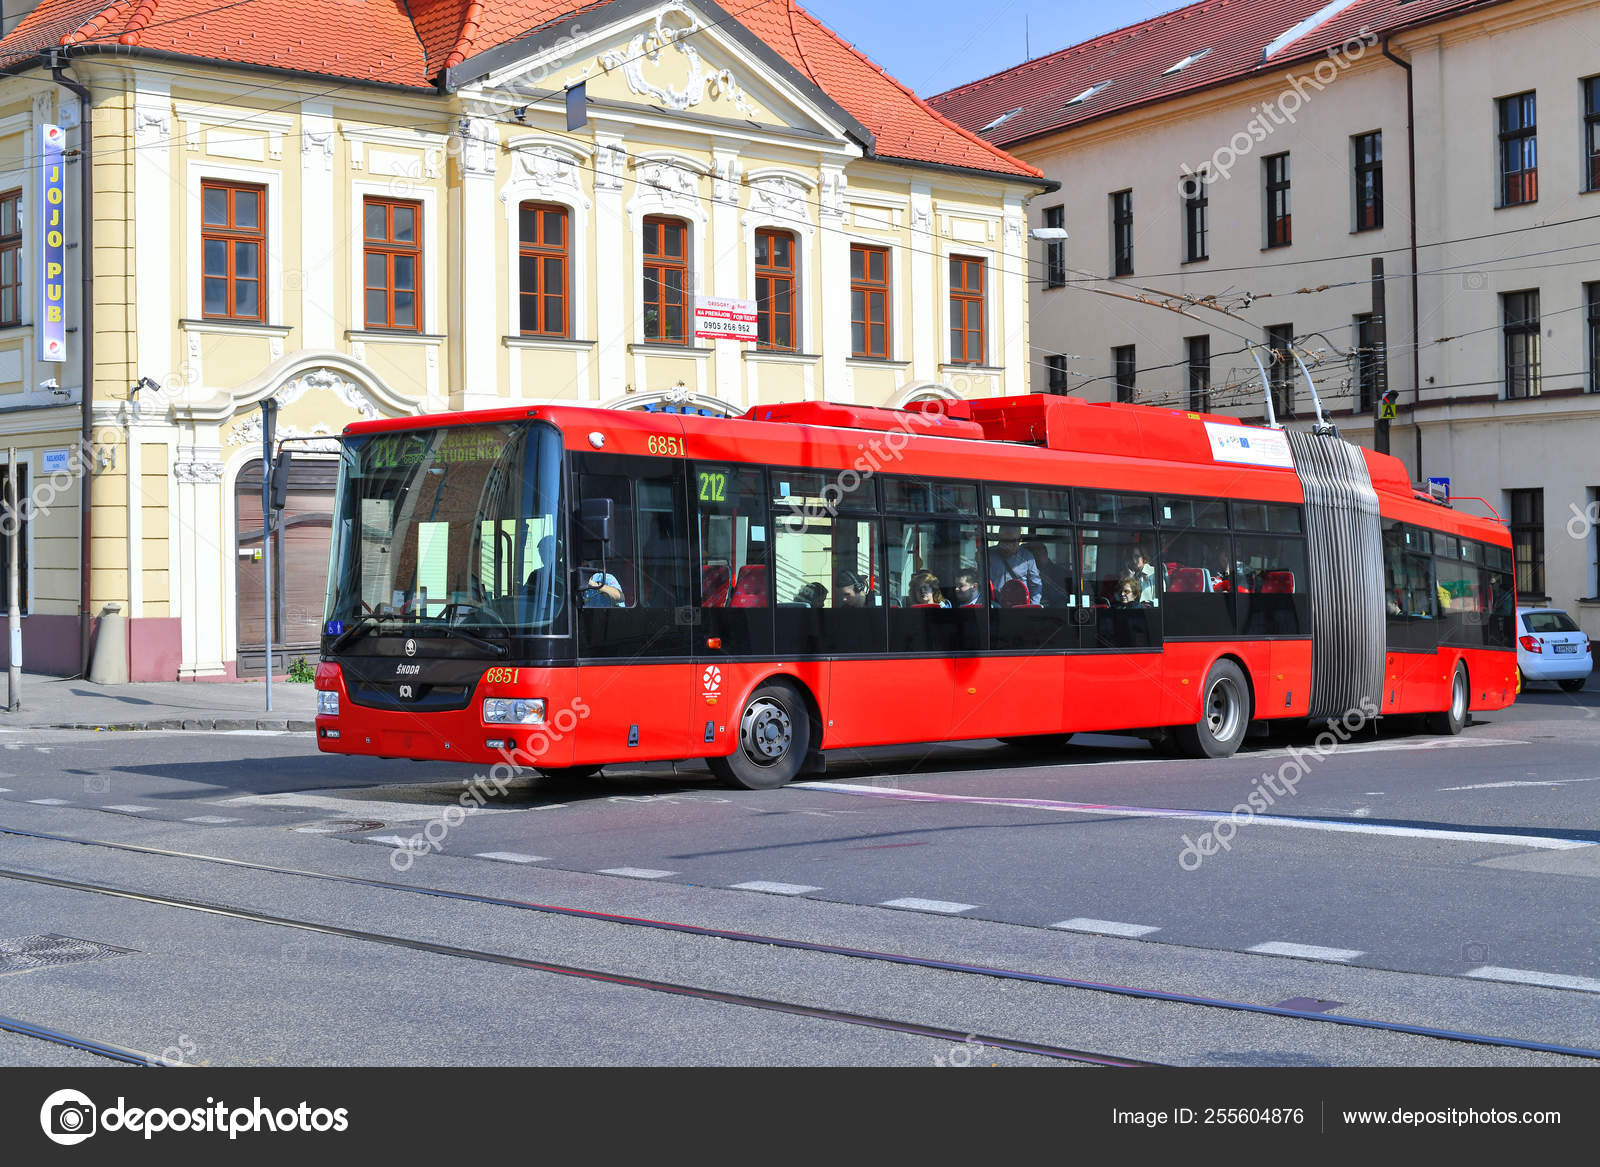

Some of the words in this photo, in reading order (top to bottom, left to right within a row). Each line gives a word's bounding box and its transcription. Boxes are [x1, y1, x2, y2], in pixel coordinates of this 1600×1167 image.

[47, 166, 63, 248] JOJO
[47, 262, 62, 322] PUB
[703, 321, 721, 330] 0905
[1383, 406, 1395, 417] A
[375, 439, 398, 468] 212
[647, 434, 685, 456] 6851
[699, 472, 725, 502] 212
[486, 668, 519, 684] 6851
